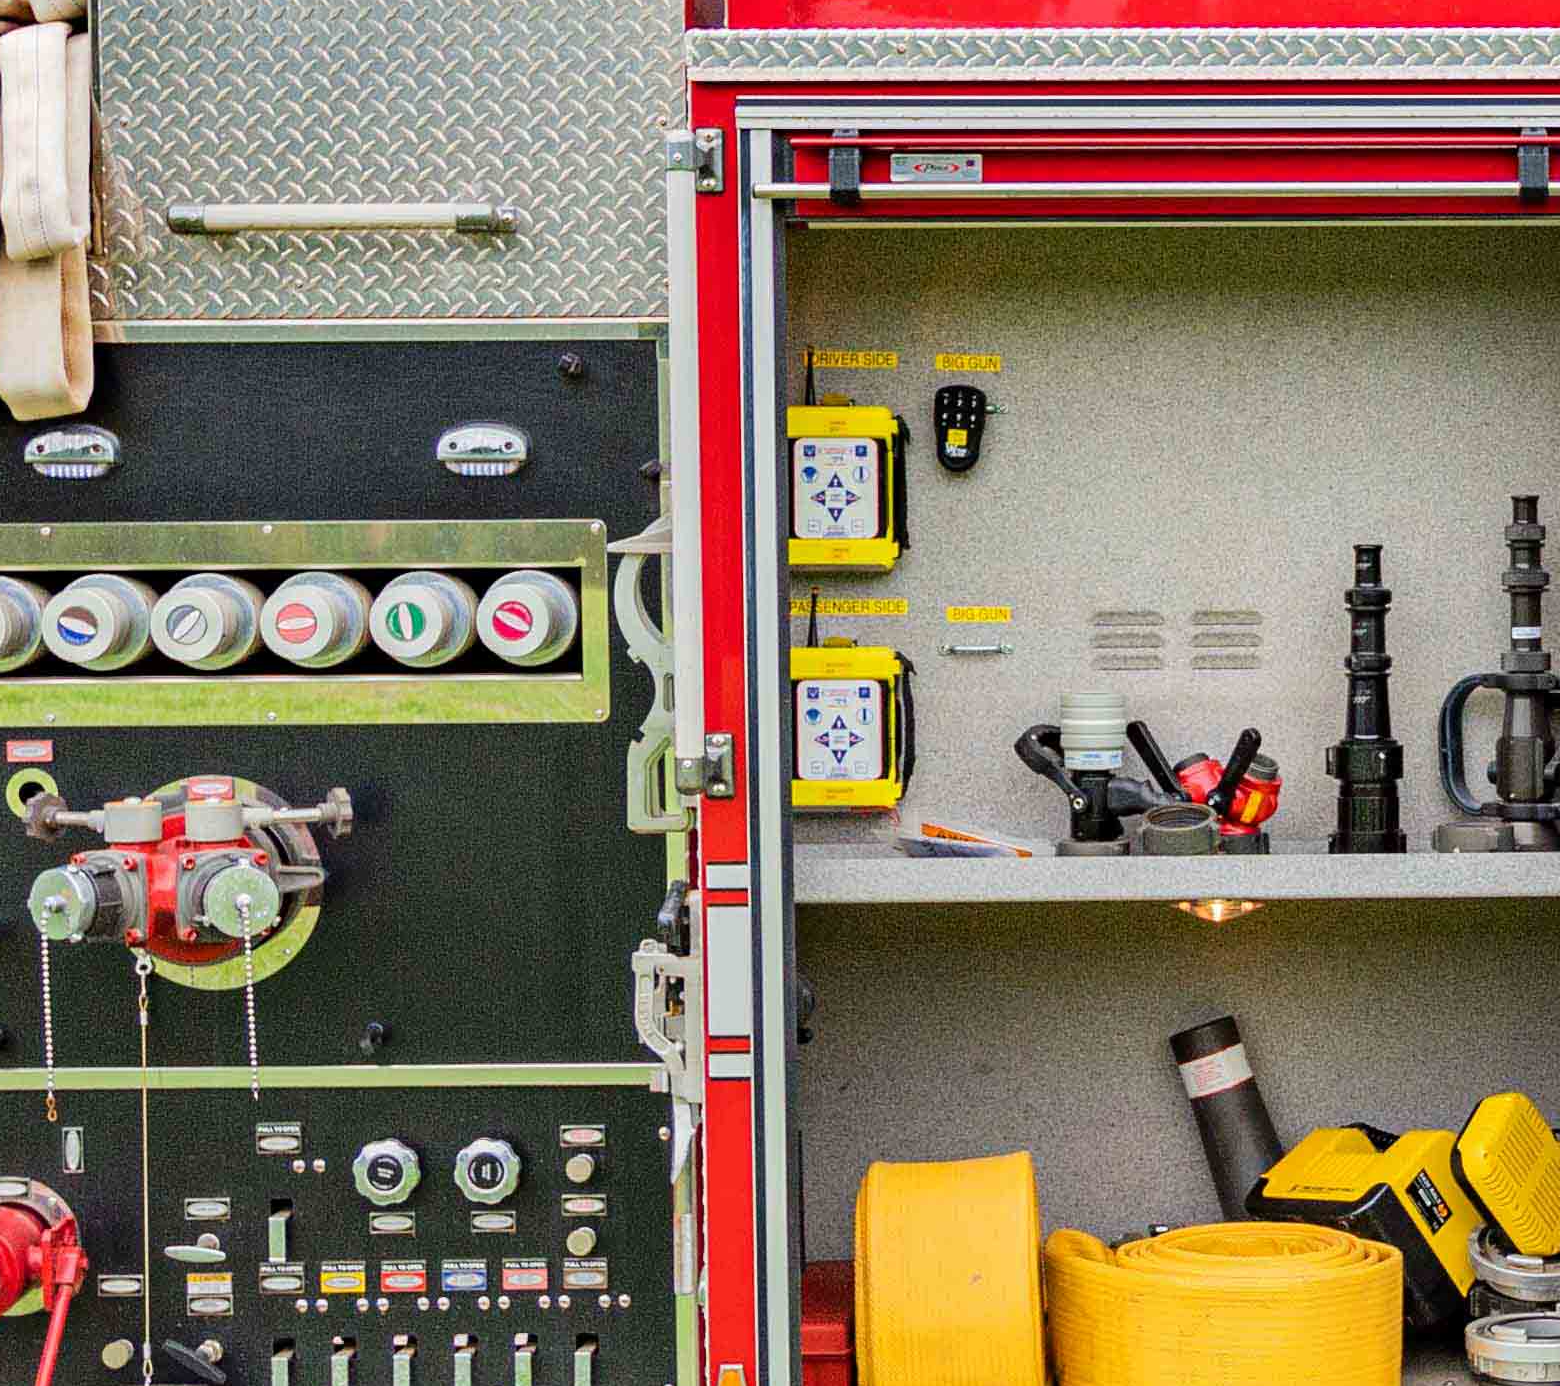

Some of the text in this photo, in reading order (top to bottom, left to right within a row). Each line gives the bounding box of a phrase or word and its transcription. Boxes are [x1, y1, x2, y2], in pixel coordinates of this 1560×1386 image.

[812, 351, 895, 366] DRIVER SIDE
[942, 356, 999, 369] BIG GUN
[790, 599, 906, 614] PASSENGER SIDE
[952, 609, 1009, 621] BIG GUN
